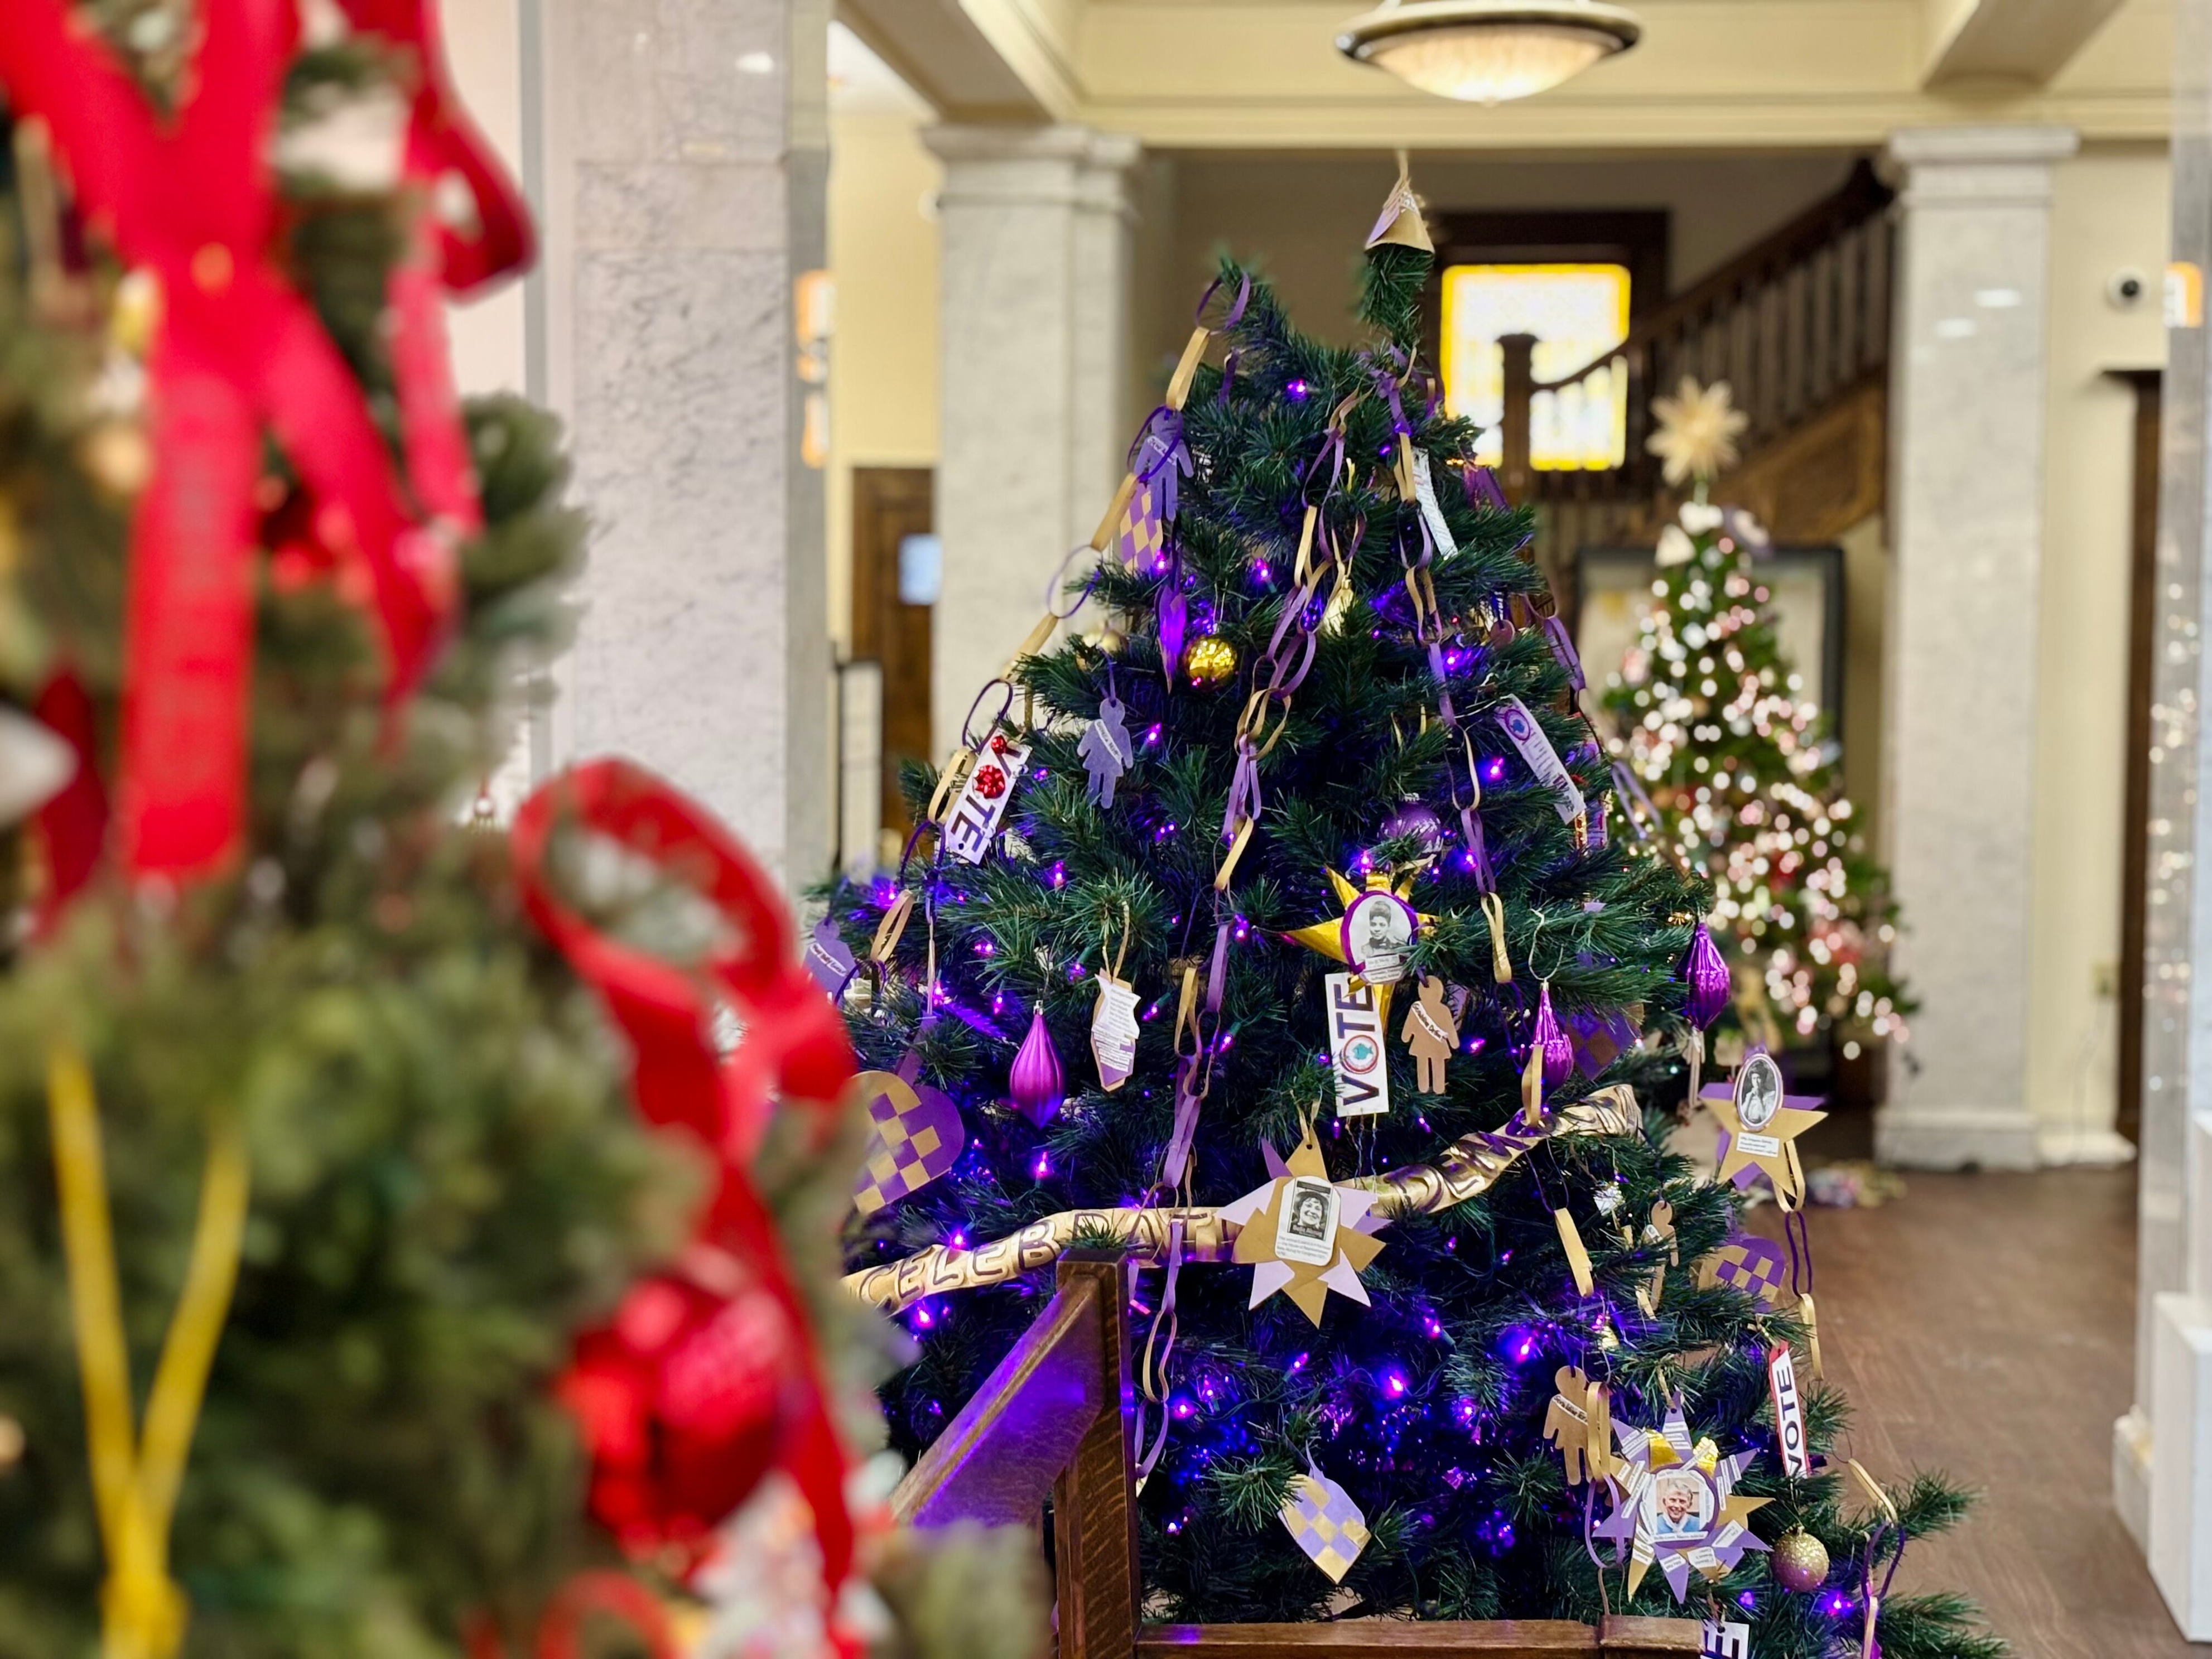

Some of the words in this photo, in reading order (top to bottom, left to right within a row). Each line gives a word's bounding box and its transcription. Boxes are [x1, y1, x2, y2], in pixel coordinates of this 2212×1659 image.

[950, 736, 1022, 852] VTE
[1334, 983, 1379, 1106] VOTE
[1776, 1366, 1802, 1478] VOTE
